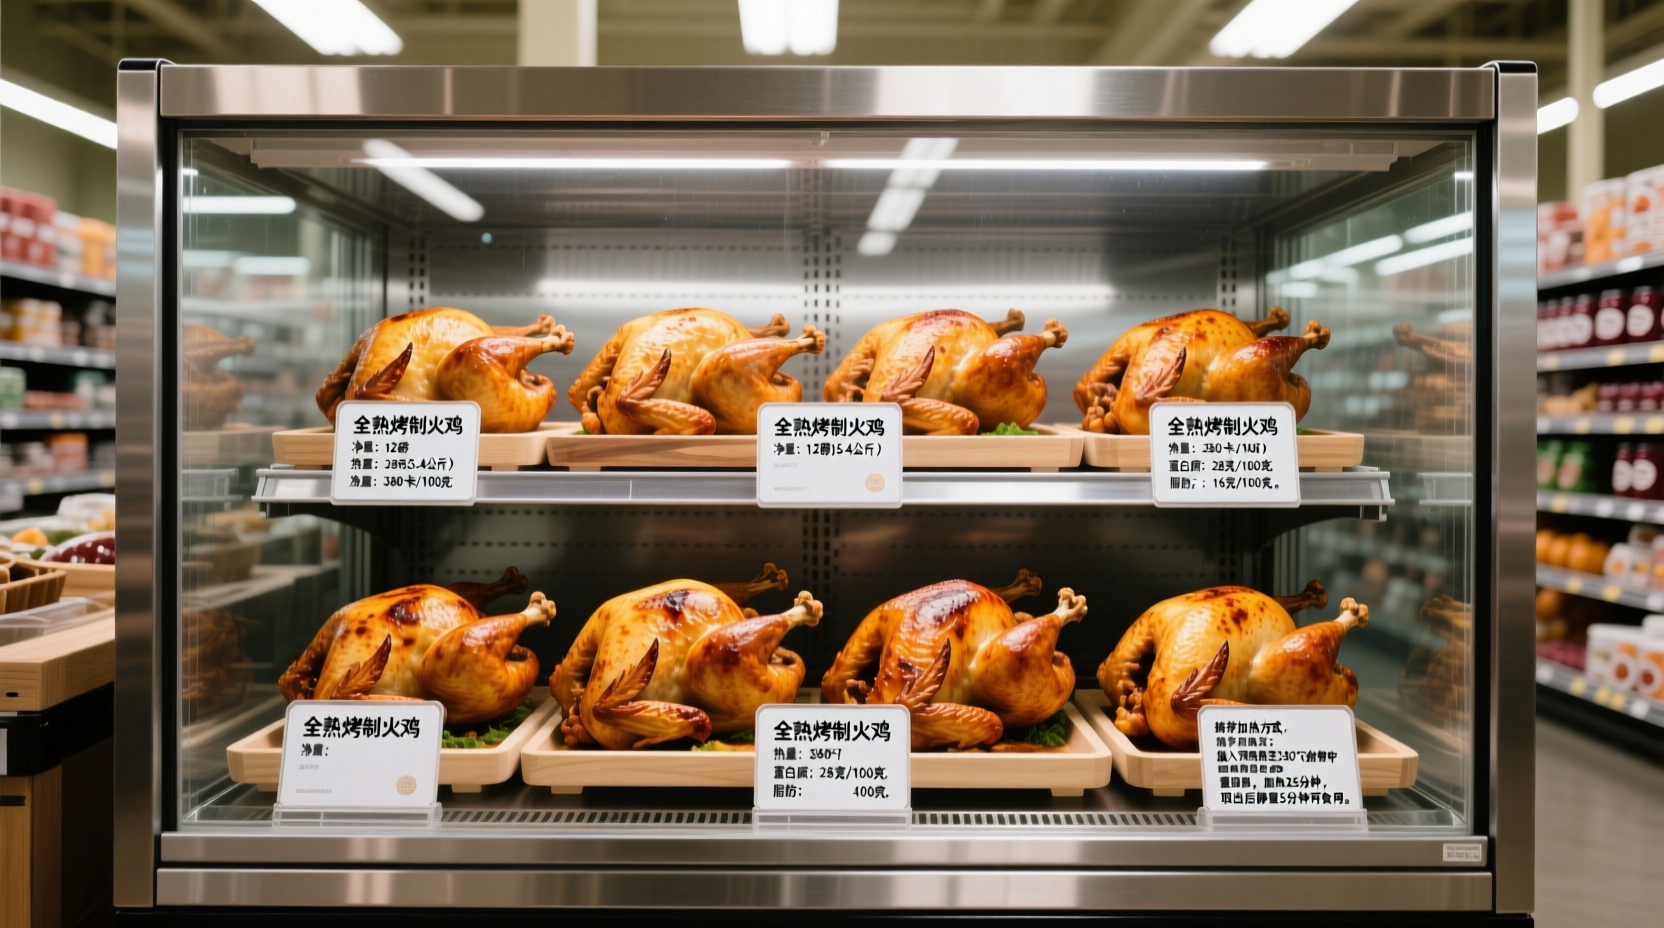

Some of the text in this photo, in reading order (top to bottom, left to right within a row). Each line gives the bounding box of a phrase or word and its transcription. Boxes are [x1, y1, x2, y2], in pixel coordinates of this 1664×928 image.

[353, 414, 463, 435] 全熟烤制火鸡
[774, 416, 885, 437] 全熟烤制火鸡
[1168, 416, 1278, 436] 全熟烤制火鸡
[303, 715, 420, 739] 全熟烤制火鸡
[773, 719, 891, 742] 全熟烤制火鸡
